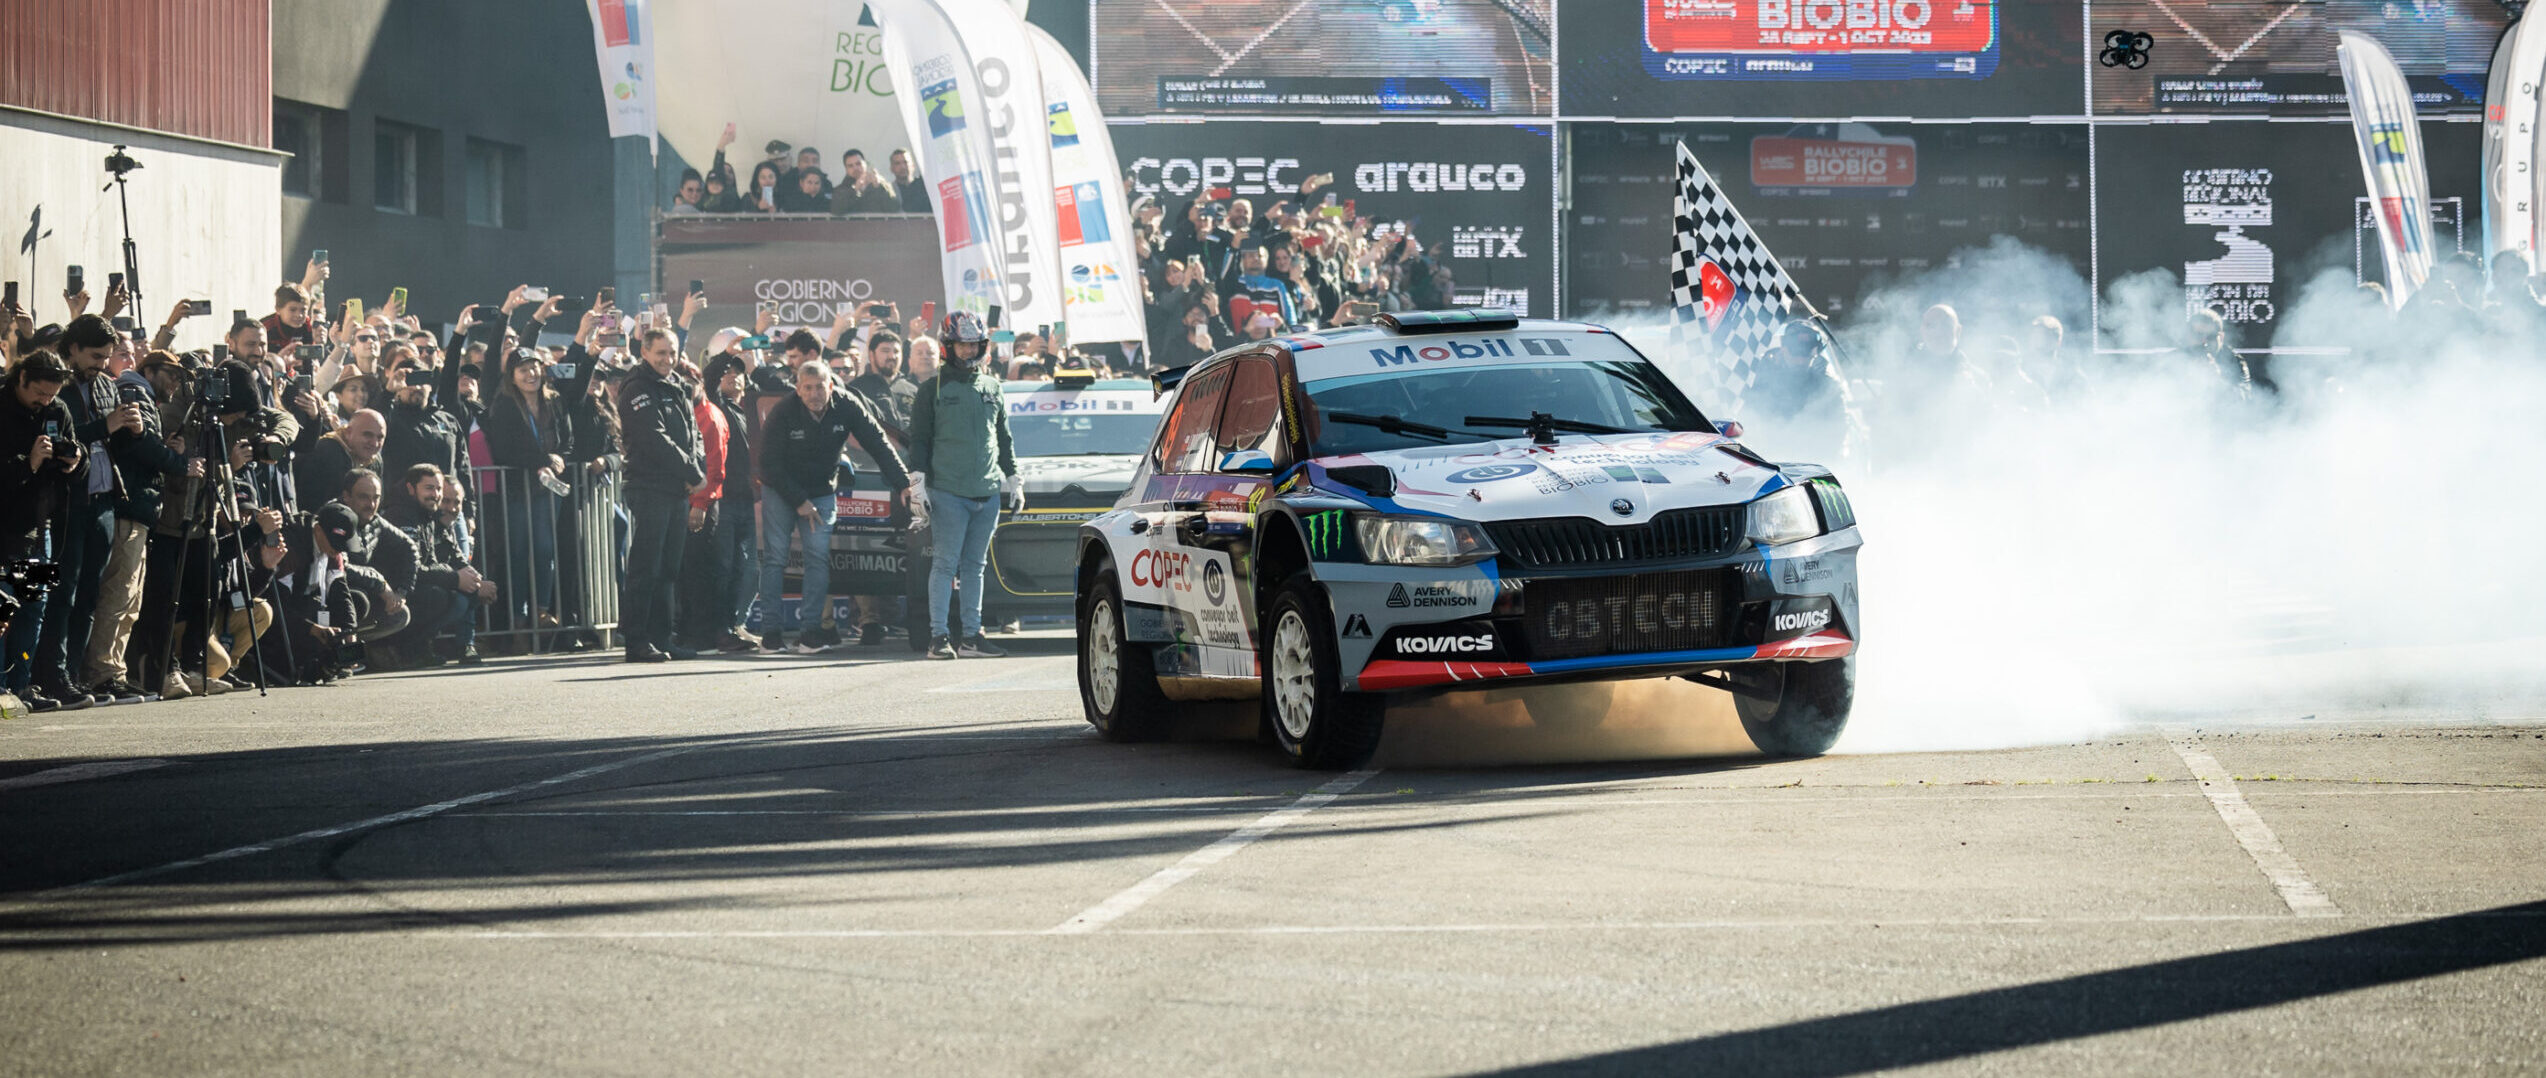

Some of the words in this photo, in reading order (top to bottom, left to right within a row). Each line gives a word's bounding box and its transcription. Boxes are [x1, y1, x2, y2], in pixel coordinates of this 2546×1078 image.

[1850, 31, 1887, 44] OCT
[1132, 157, 1300, 195] COPEC
[1354, 162, 1527, 192] arauco
[754, 279, 873, 300] GOBIERNO
[1369, 338, 1515, 367] Mobil
[1010, 400, 1097, 413] Mobil
[1131, 549, 1192, 592] COPEC
[1413, 597, 1477, 607] DENNISON
[1414, 587, 1452, 596] AVERY
[1201, 608, 1225, 627] conveyor
[1225, 604, 1240, 624] belt
[1775, 609, 1829, 630] KOVACS
[1206, 624, 1241, 650] technology
[1396, 634, 1494, 653] KOVACS
